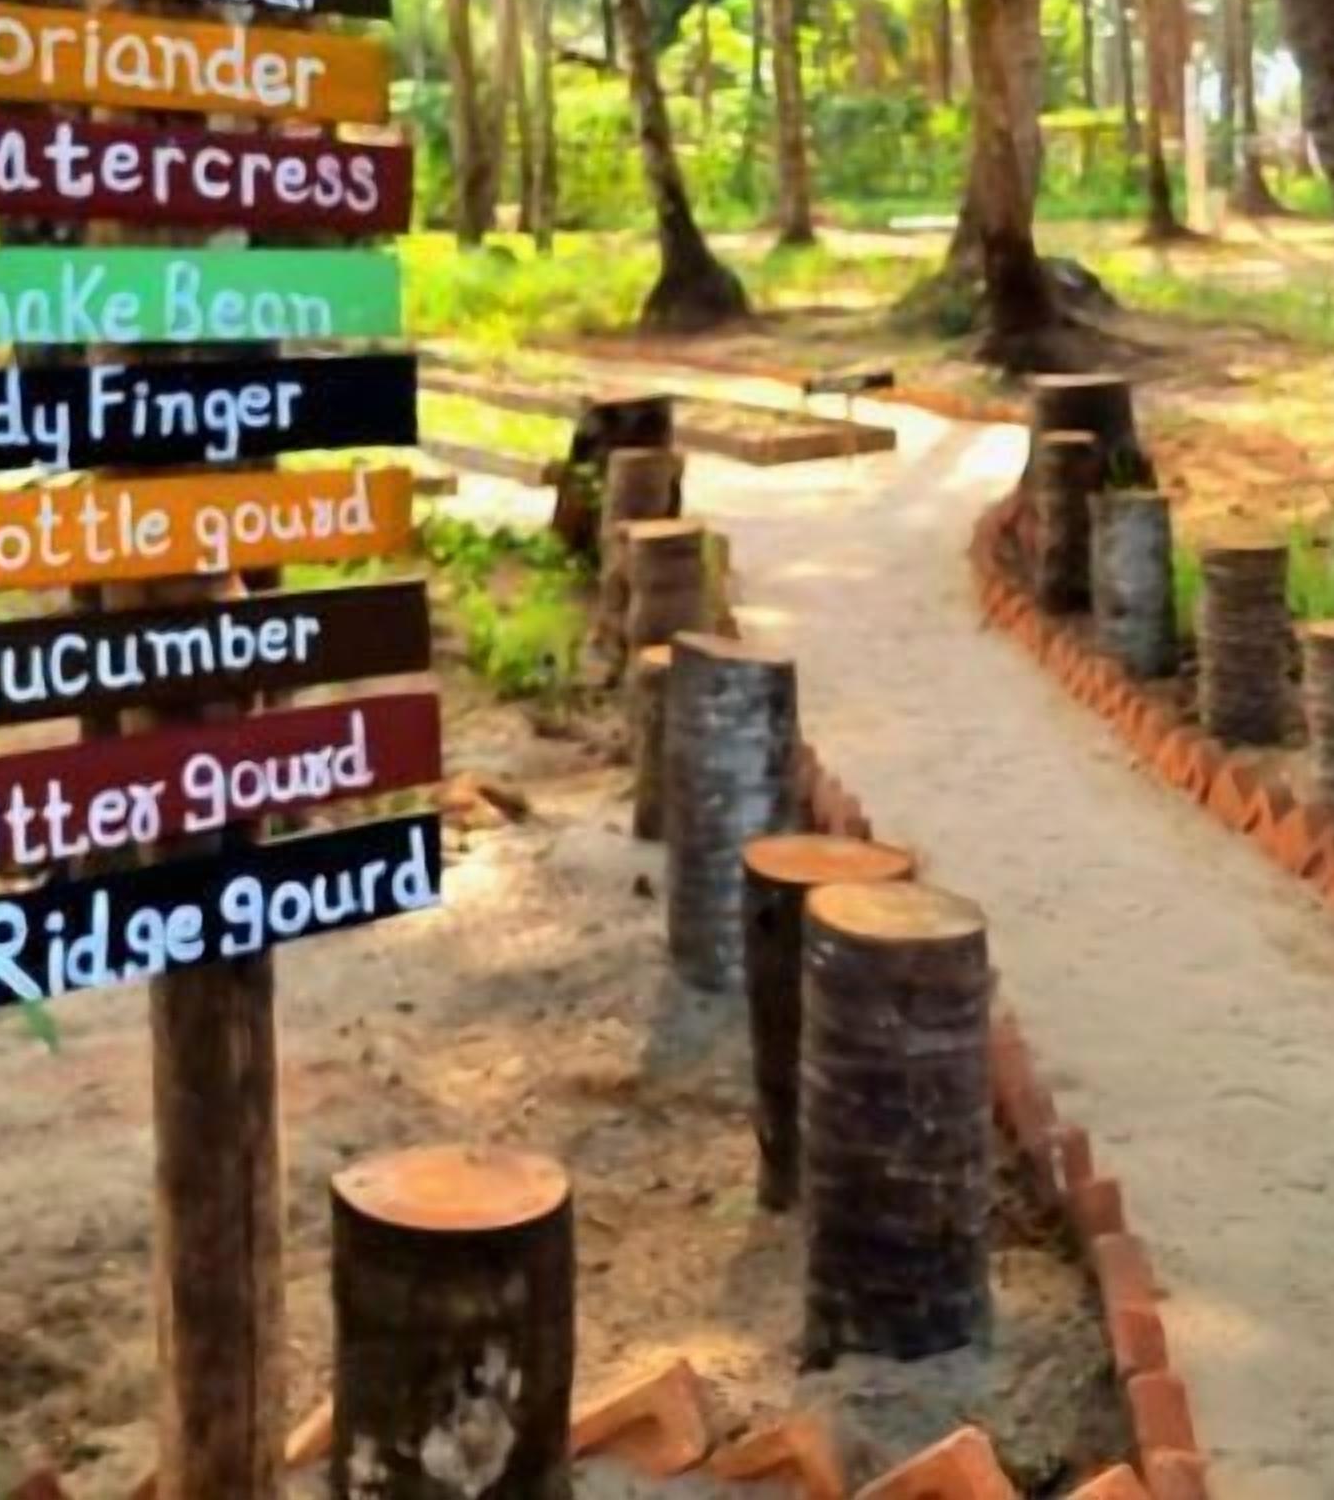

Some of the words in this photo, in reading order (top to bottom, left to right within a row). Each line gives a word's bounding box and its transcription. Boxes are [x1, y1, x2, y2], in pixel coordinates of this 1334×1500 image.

[166, 260, 334, 342] Bean
[88, 364, 303, 461] Finger
[196, 465, 375, 574] gourd
[181, 708, 374, 833] gourd
[219, 824, 443, 957] gourd
